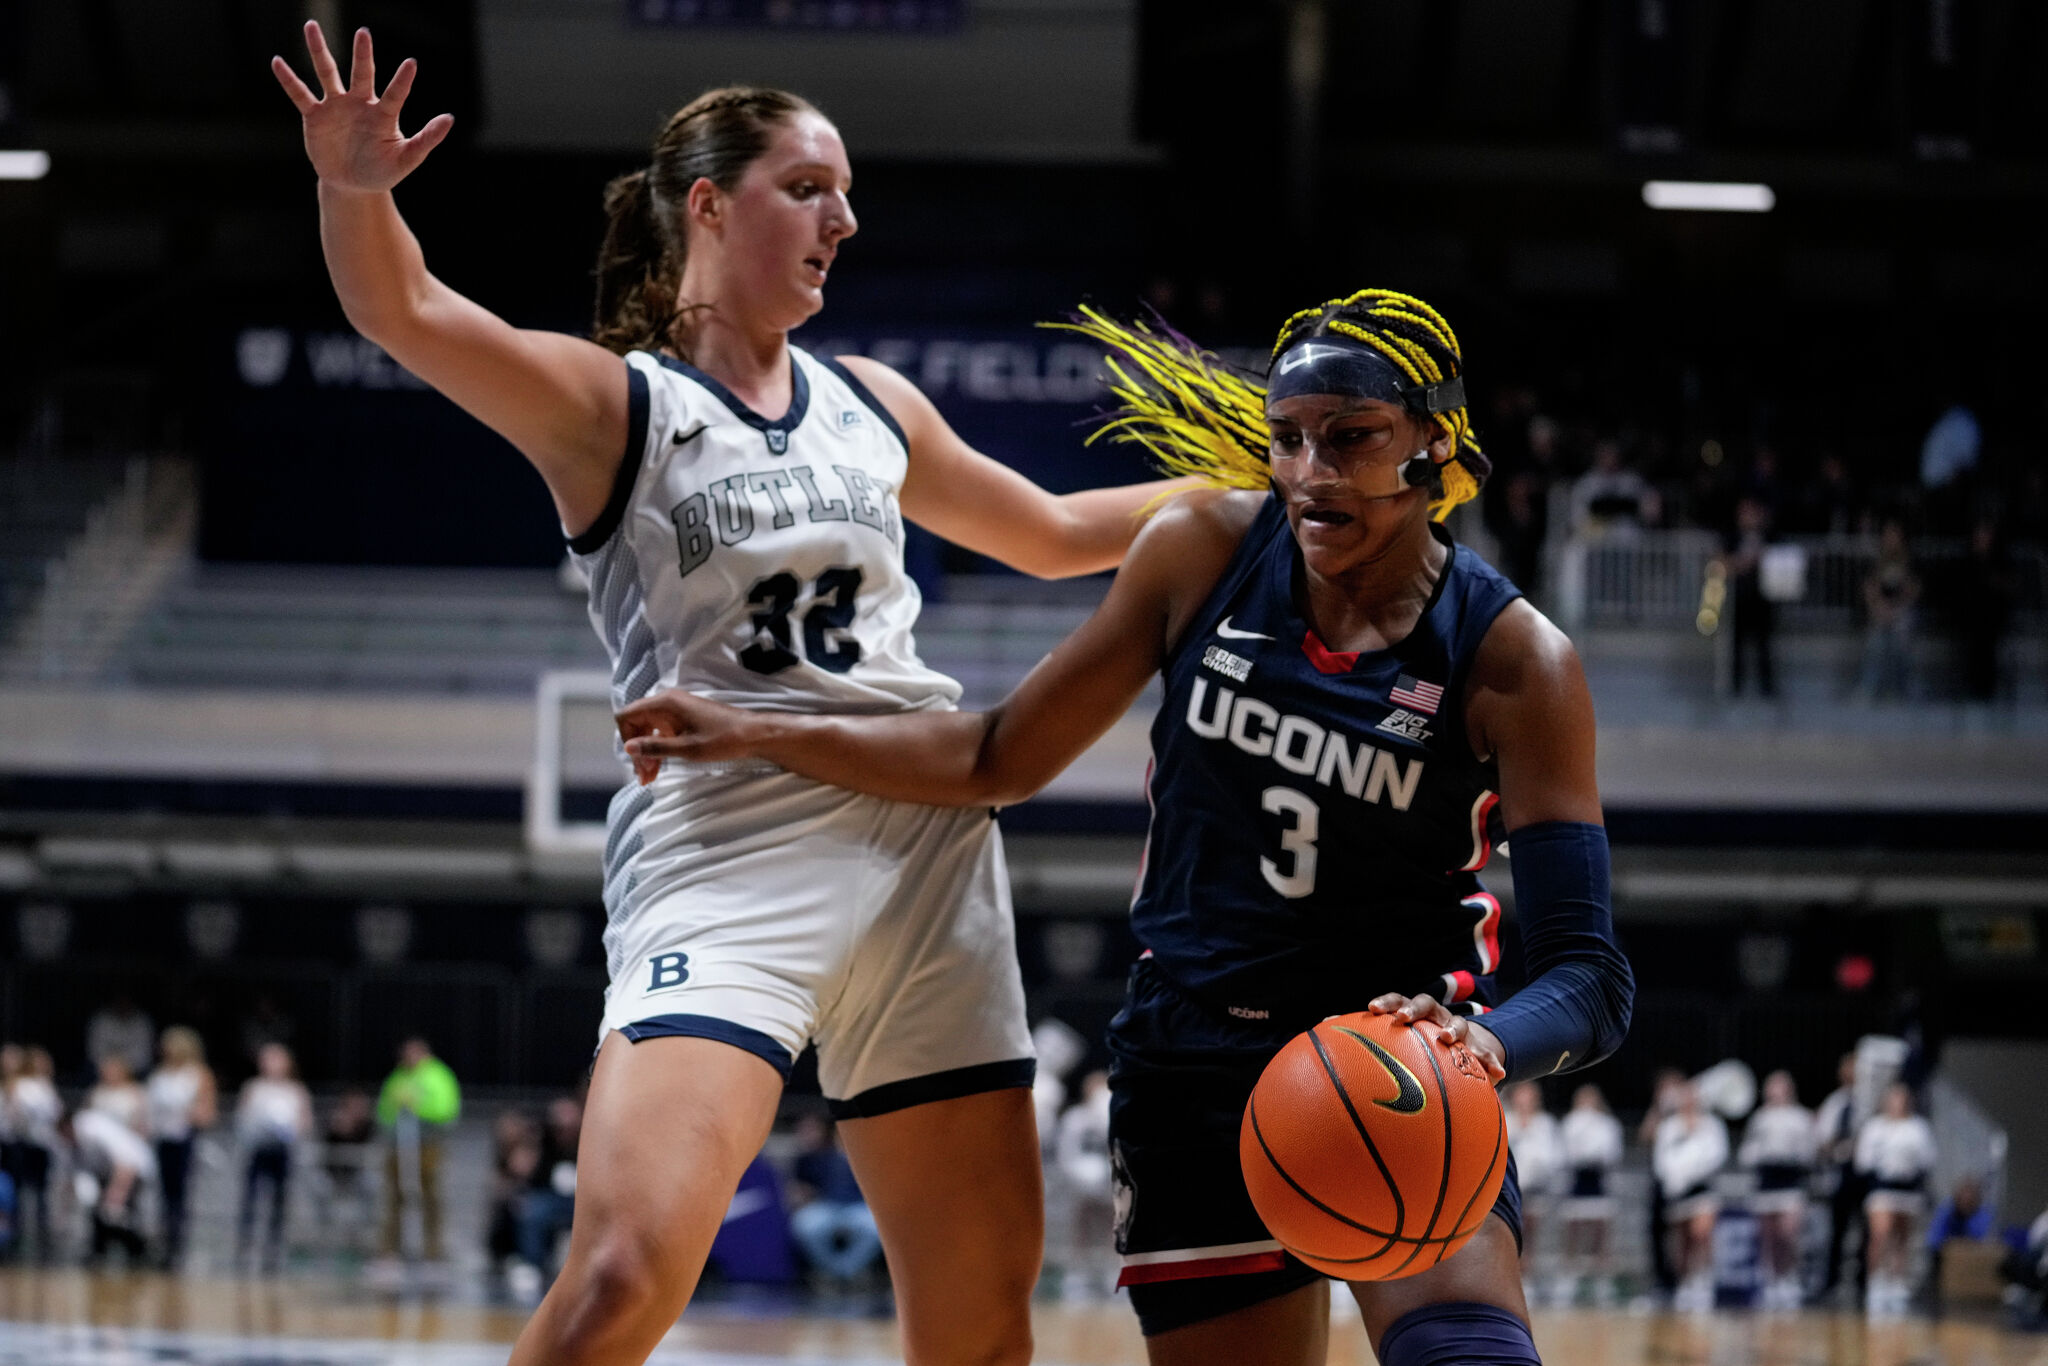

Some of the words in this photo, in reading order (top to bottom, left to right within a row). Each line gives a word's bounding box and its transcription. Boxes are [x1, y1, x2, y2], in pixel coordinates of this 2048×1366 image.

[738, 563, 864, 676] 32
[1380, 715, 1434, 741] EAST
[1390, 708, 1429, 729] BIG
[1186, 675, 1425, 812] UCONN
[1260, 785, 1320, 899] 3
[646, 951, 690, 992] B
[1228, 1006, 1269, 1020] UCONN
